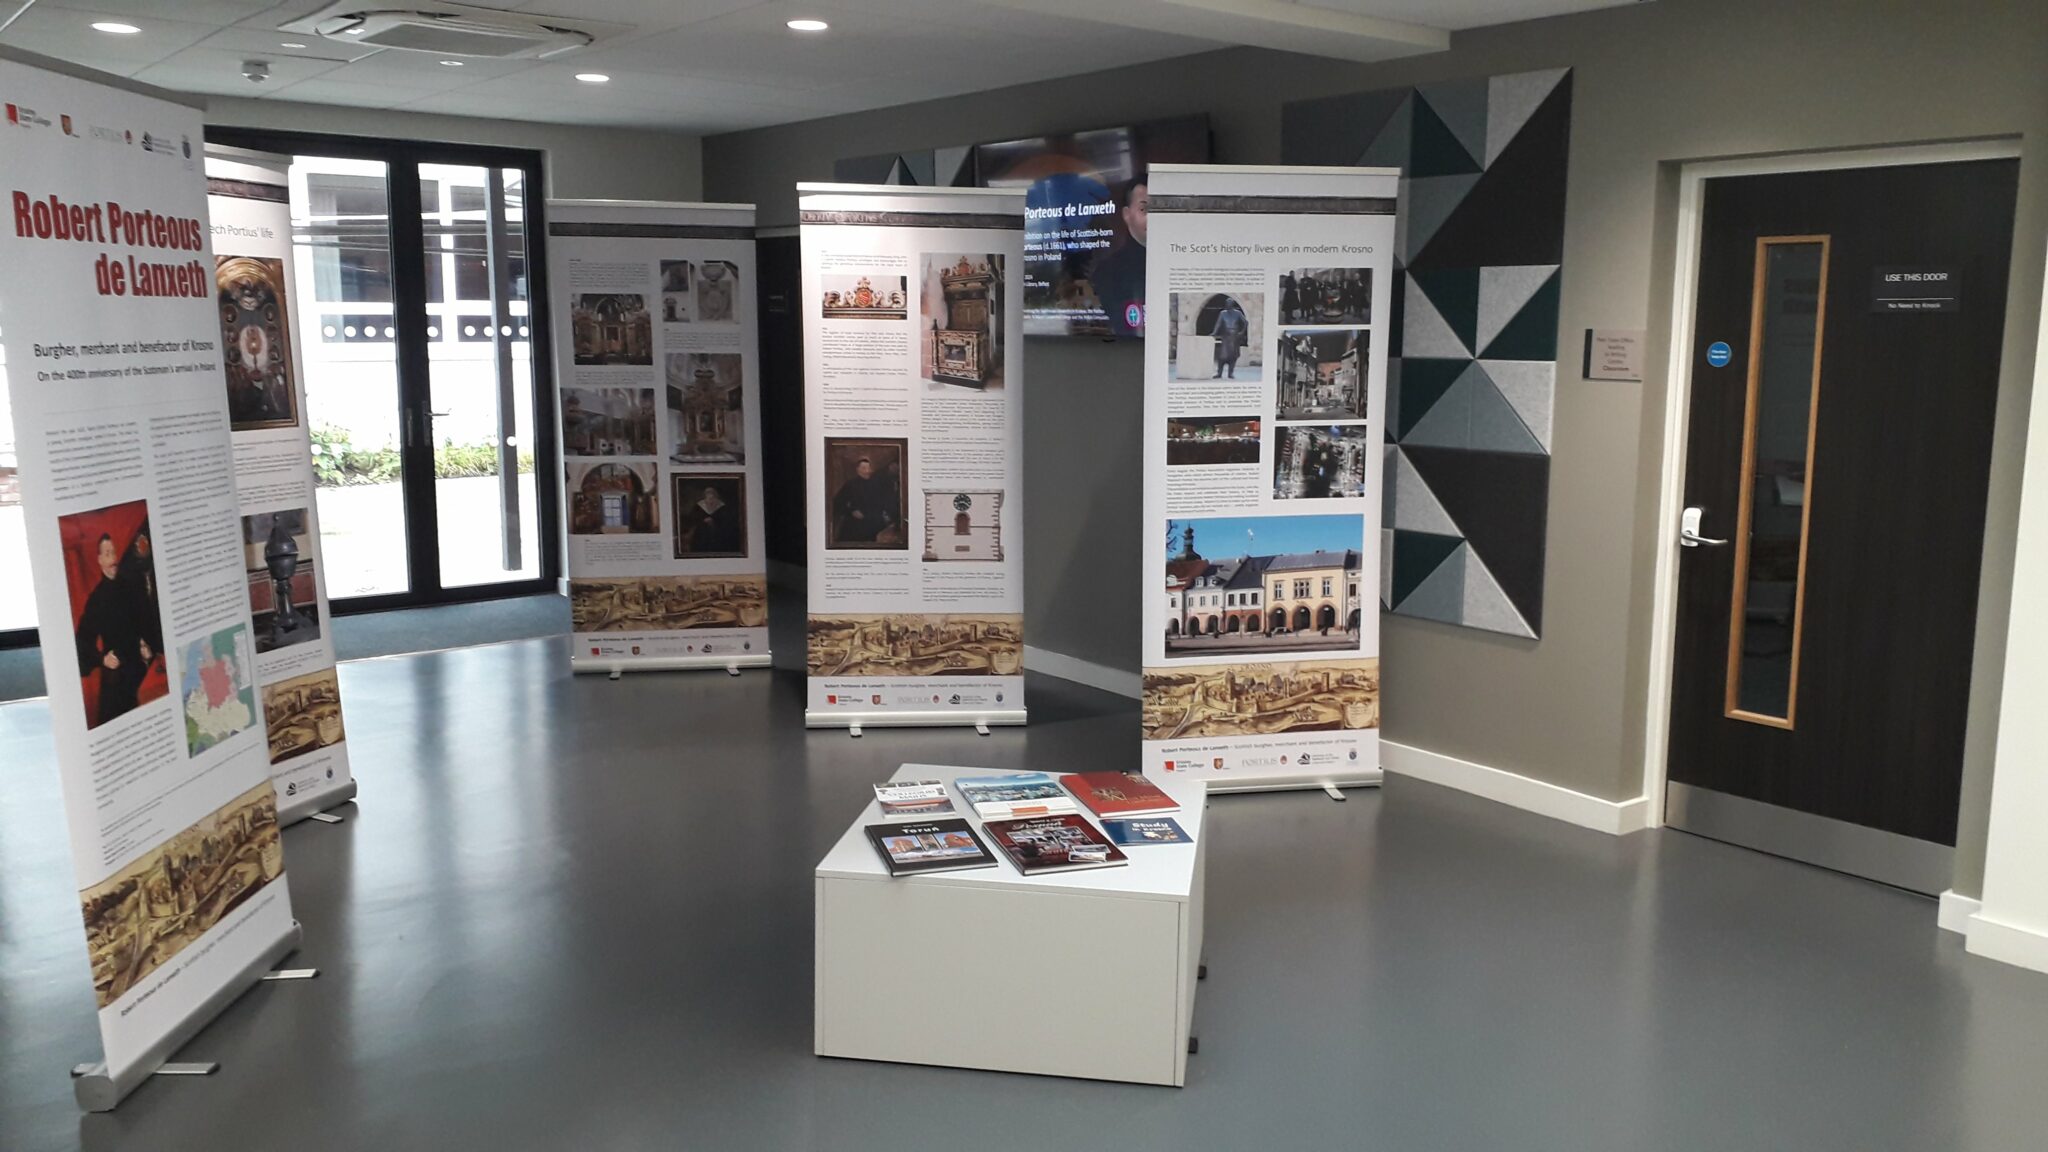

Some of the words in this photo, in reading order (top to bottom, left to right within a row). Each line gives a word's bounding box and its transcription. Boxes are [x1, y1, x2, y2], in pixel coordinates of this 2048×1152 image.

[1024, 206, 1063, 219] Porteous
[1064, 202, 1077, 217] de
[1078, 200, 1116, 216] Lanxeth
[12, 190, 105, 243] Robert
[107, 201, 203, 251] Porteous
[209, 225, 226, 235] ech
[260, 227, 274, 239] life
[1051, 231, 1060, 239] the
[1060, 230, 1069, 239] life
[1070, 229, 1077, 238] of
[1024, 243, 1043, 251] orteous
[1067, 241, 1080, 249] who
[1080, 240, 1100, 250] shaped
[1100, 240, 1111, 248] the
[1169, 243, 1187, 253] The
[1189, 243, 1218, 253] Scot's
[1220, 243, 1252, 256] history
[1254, 244, 1275, 254] lives
[1277, 245, 1290, 254] on
[1292, 244, 1301, 254] in
[1303, 244, 1339, 254] modern
[1341, 244, 1374, 254] Krosno
[1044, 252, 1062, 261] Poland
[95, 253, 127, 297] de
[128, 254, 209, 299] Lanxeth
[1885, 273, 1902, 282] USE
[1903, 273, 1922, 282] THIS
[1923, 272, 1949, 282] DOOR
[33, 341, 79, 360] Burgher,
[80, 341, 120, 355] merchant
[121, 341, 138, 354] and
[139, 340, 181, 353] benefactor
[182, 339, 190, 351] of
[37, 370, 50, 382] On
[51, 369, 65, 381] the
[124, 366, 131, 377] of
[132, 366, 142, 376] the
[1131, 821, 1169, 829] Study
